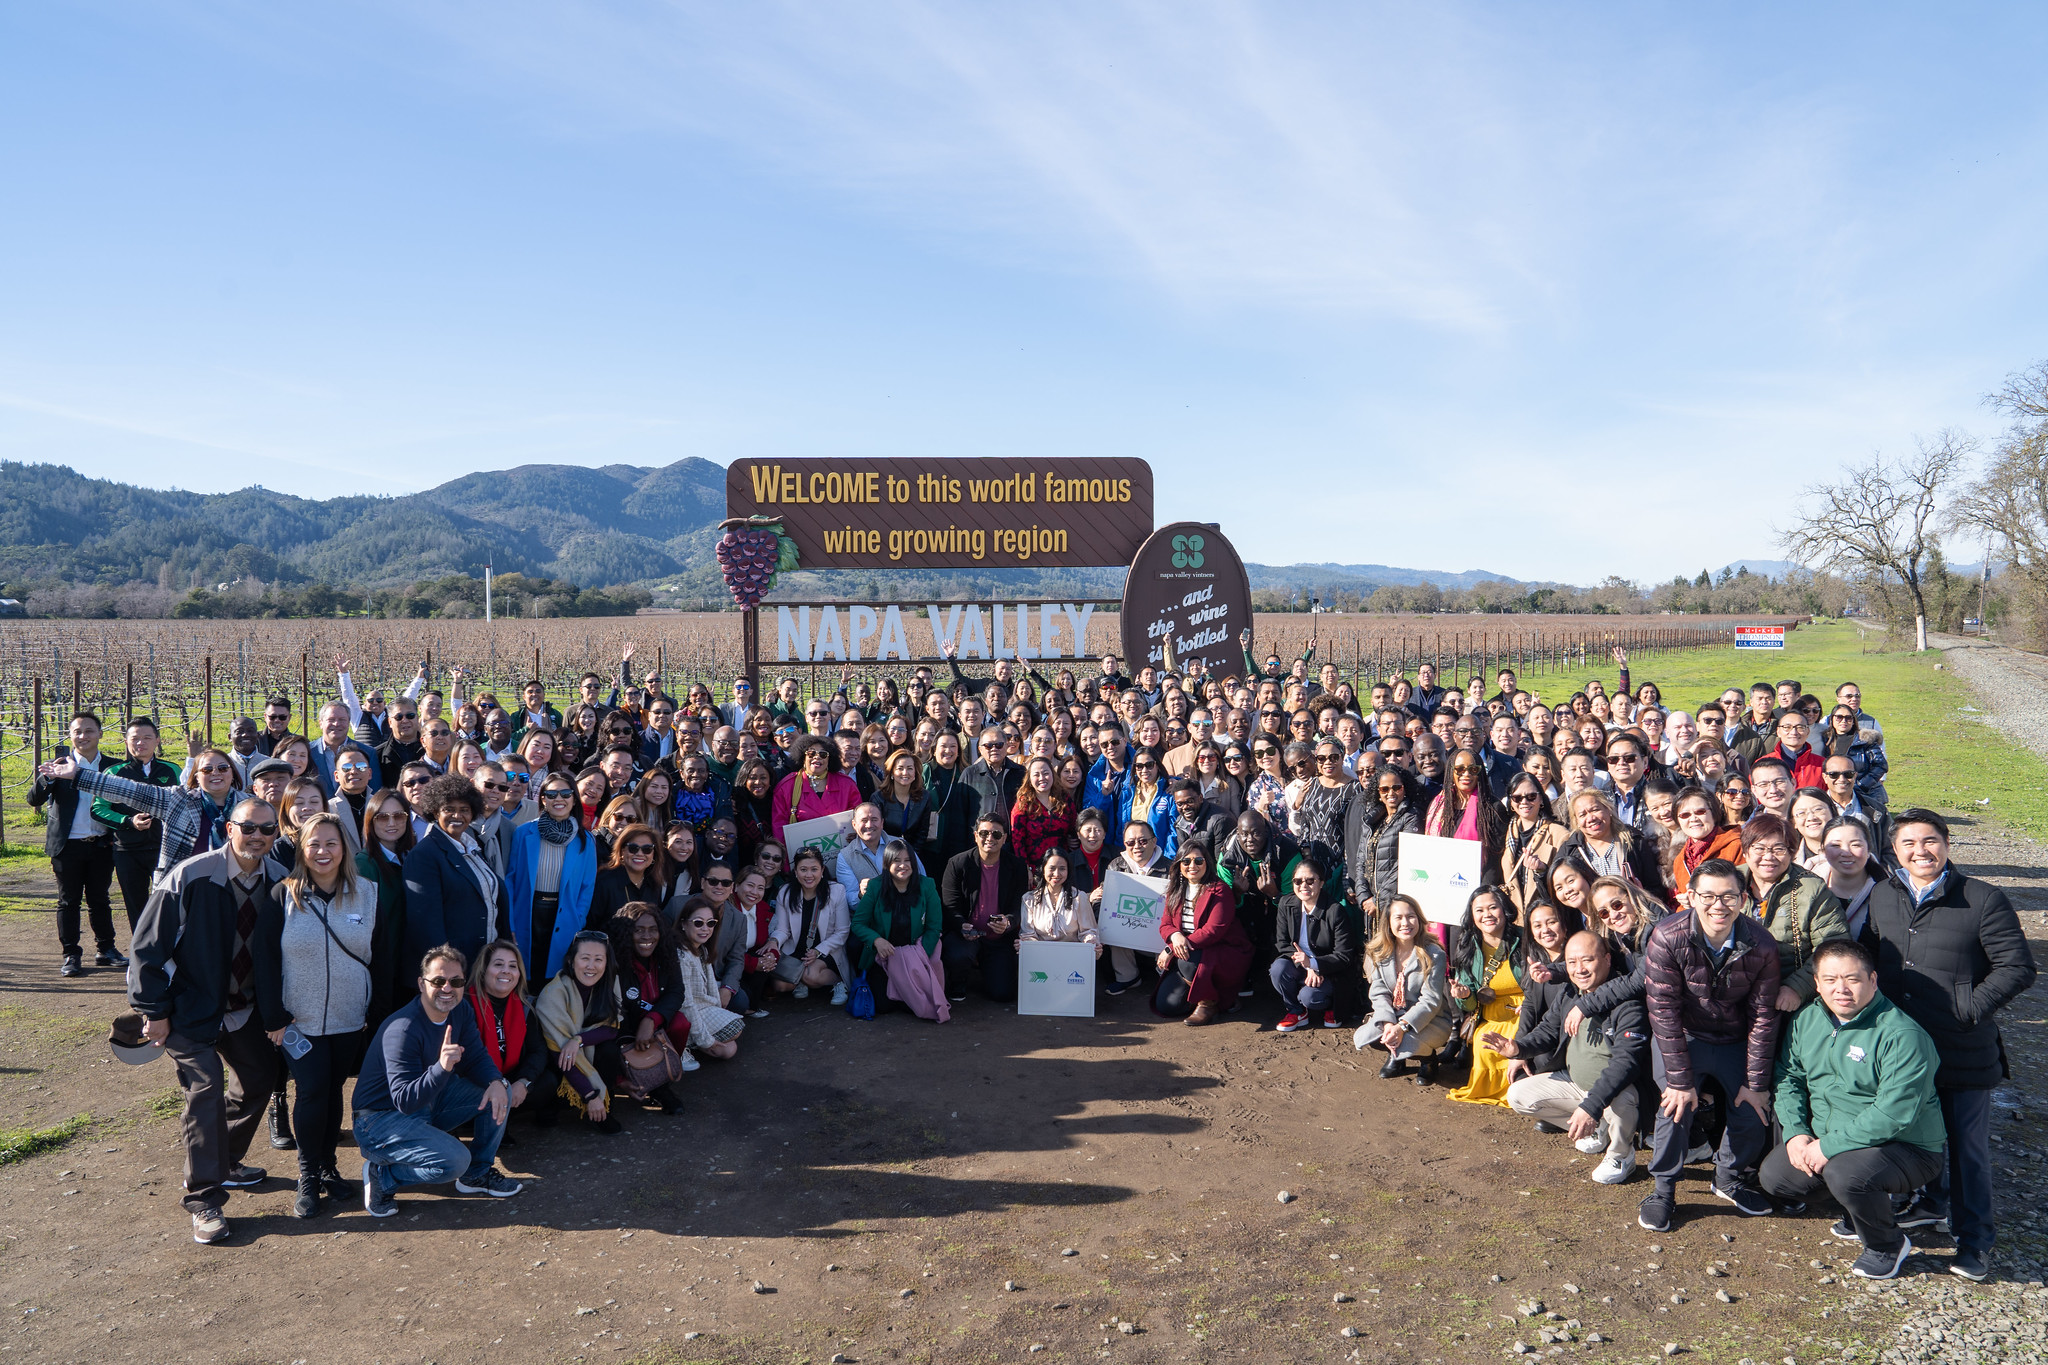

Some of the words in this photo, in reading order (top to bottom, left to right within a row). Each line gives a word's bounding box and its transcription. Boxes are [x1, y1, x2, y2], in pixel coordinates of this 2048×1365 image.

[750, 465, 880, 504] WELCOME
[886, 474, 910, 504] to
[917, 472, 962, 504] this
[968, 472, 1036, 503] world
[1044, 471, 1131, 503] famous
[823, 525, 881, 554] wine
[888, 525, 985, 560] growing
[993, 524, 1068, 560] region
[1159, 572, 1174, 580] napa
[1175, 571, 1191, 580] valley
[777, 604, 911, 662] NAPA
[926, 602, 1096, 661] VALLEY
[1147, 619, 1175, 639] the
[1187, 603, 1228, 626] wine
[1147, 645, 1163, 664] is
[1175, 623, 1229, 655] bottled
[1118, 894, 1157, 919] GX
